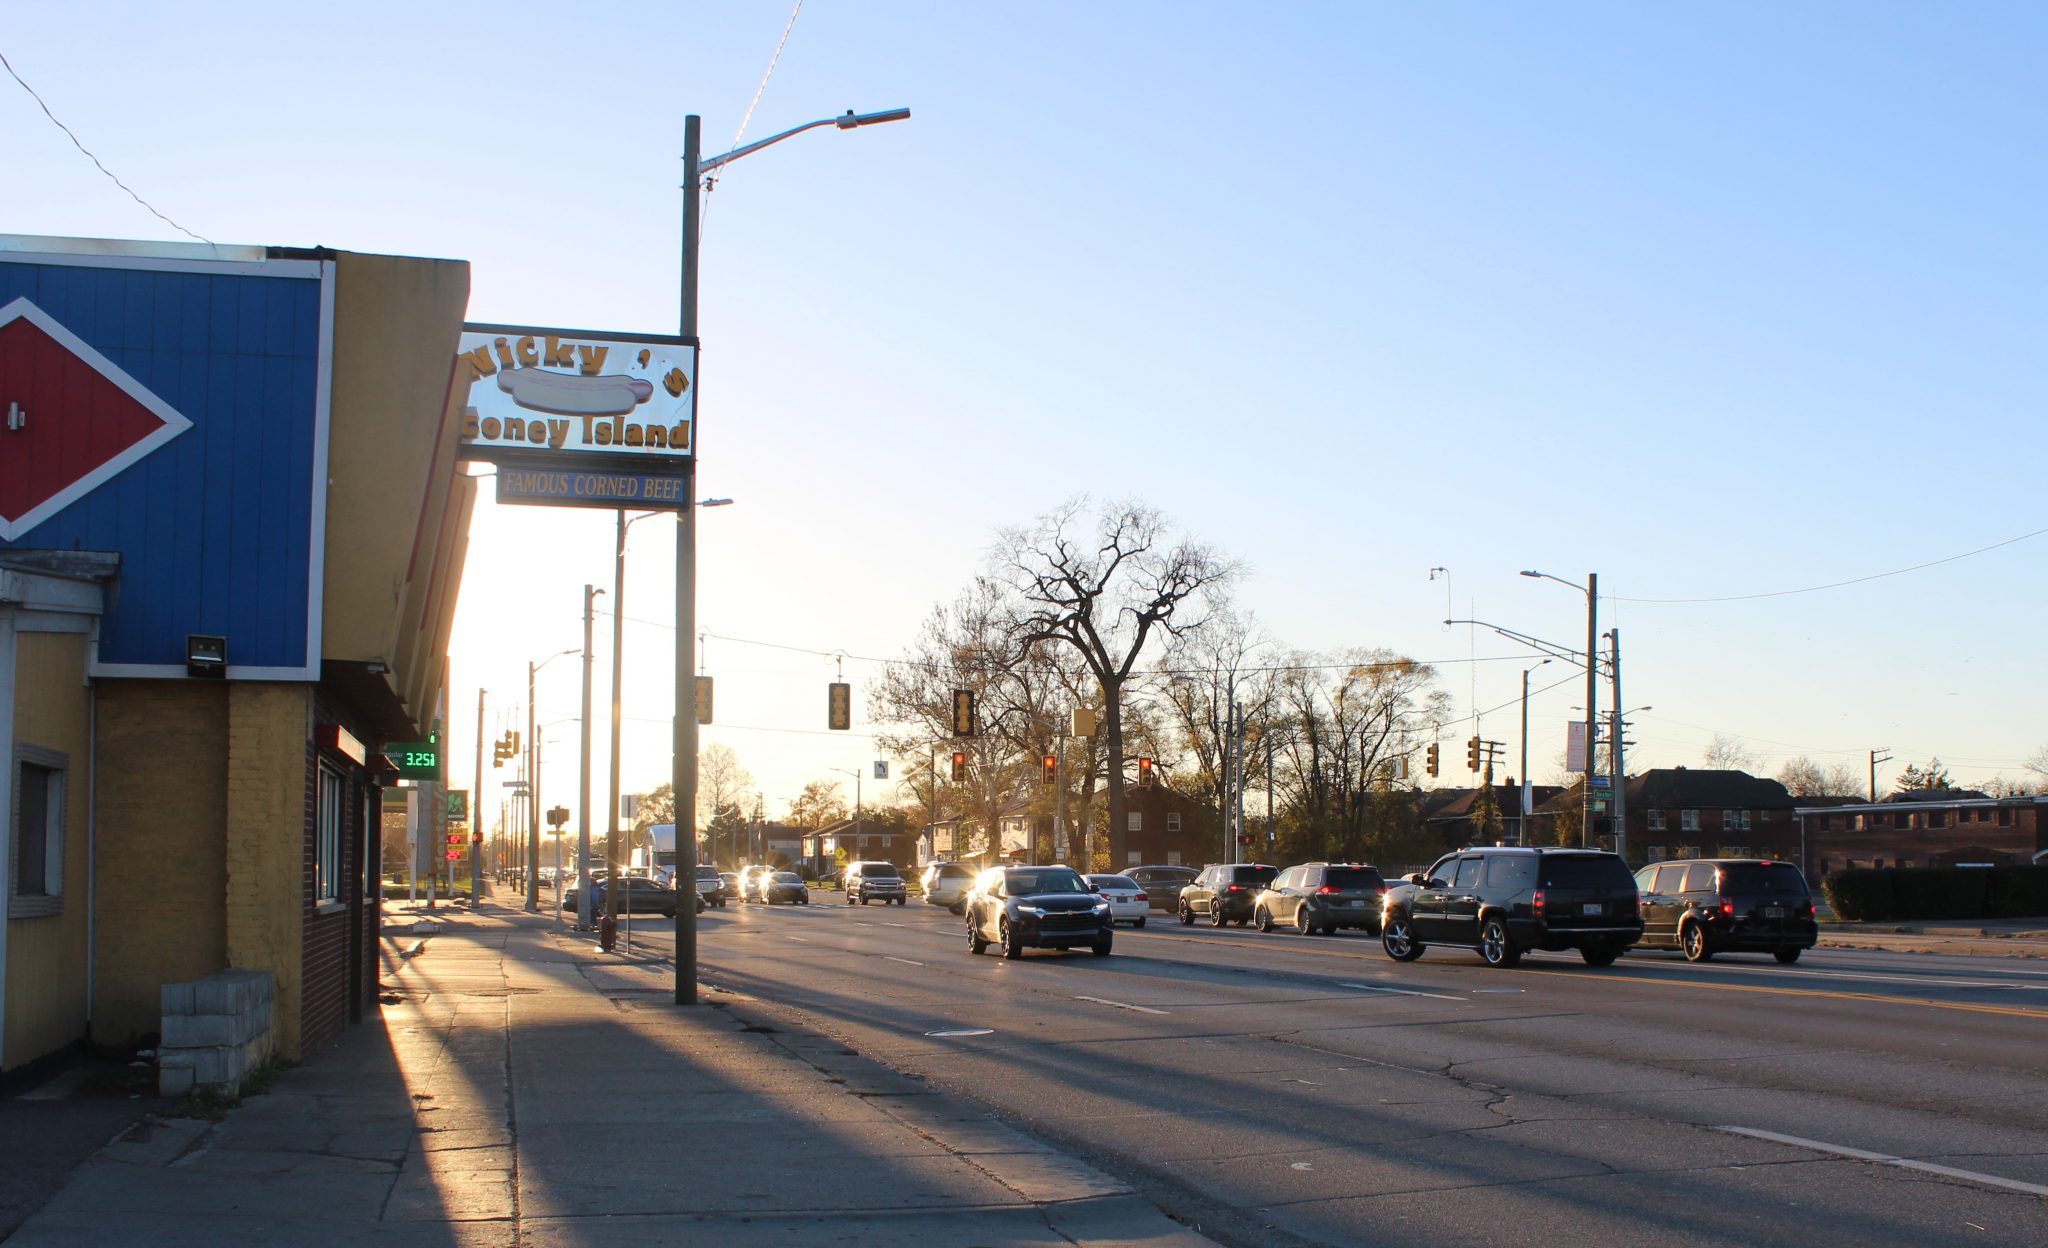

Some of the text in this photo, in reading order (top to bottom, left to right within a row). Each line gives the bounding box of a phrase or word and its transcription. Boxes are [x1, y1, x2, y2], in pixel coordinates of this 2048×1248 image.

[582, 414, 690, 450] Island
[506, 472, 682, 500] FAMOUS CORNED BEEF
